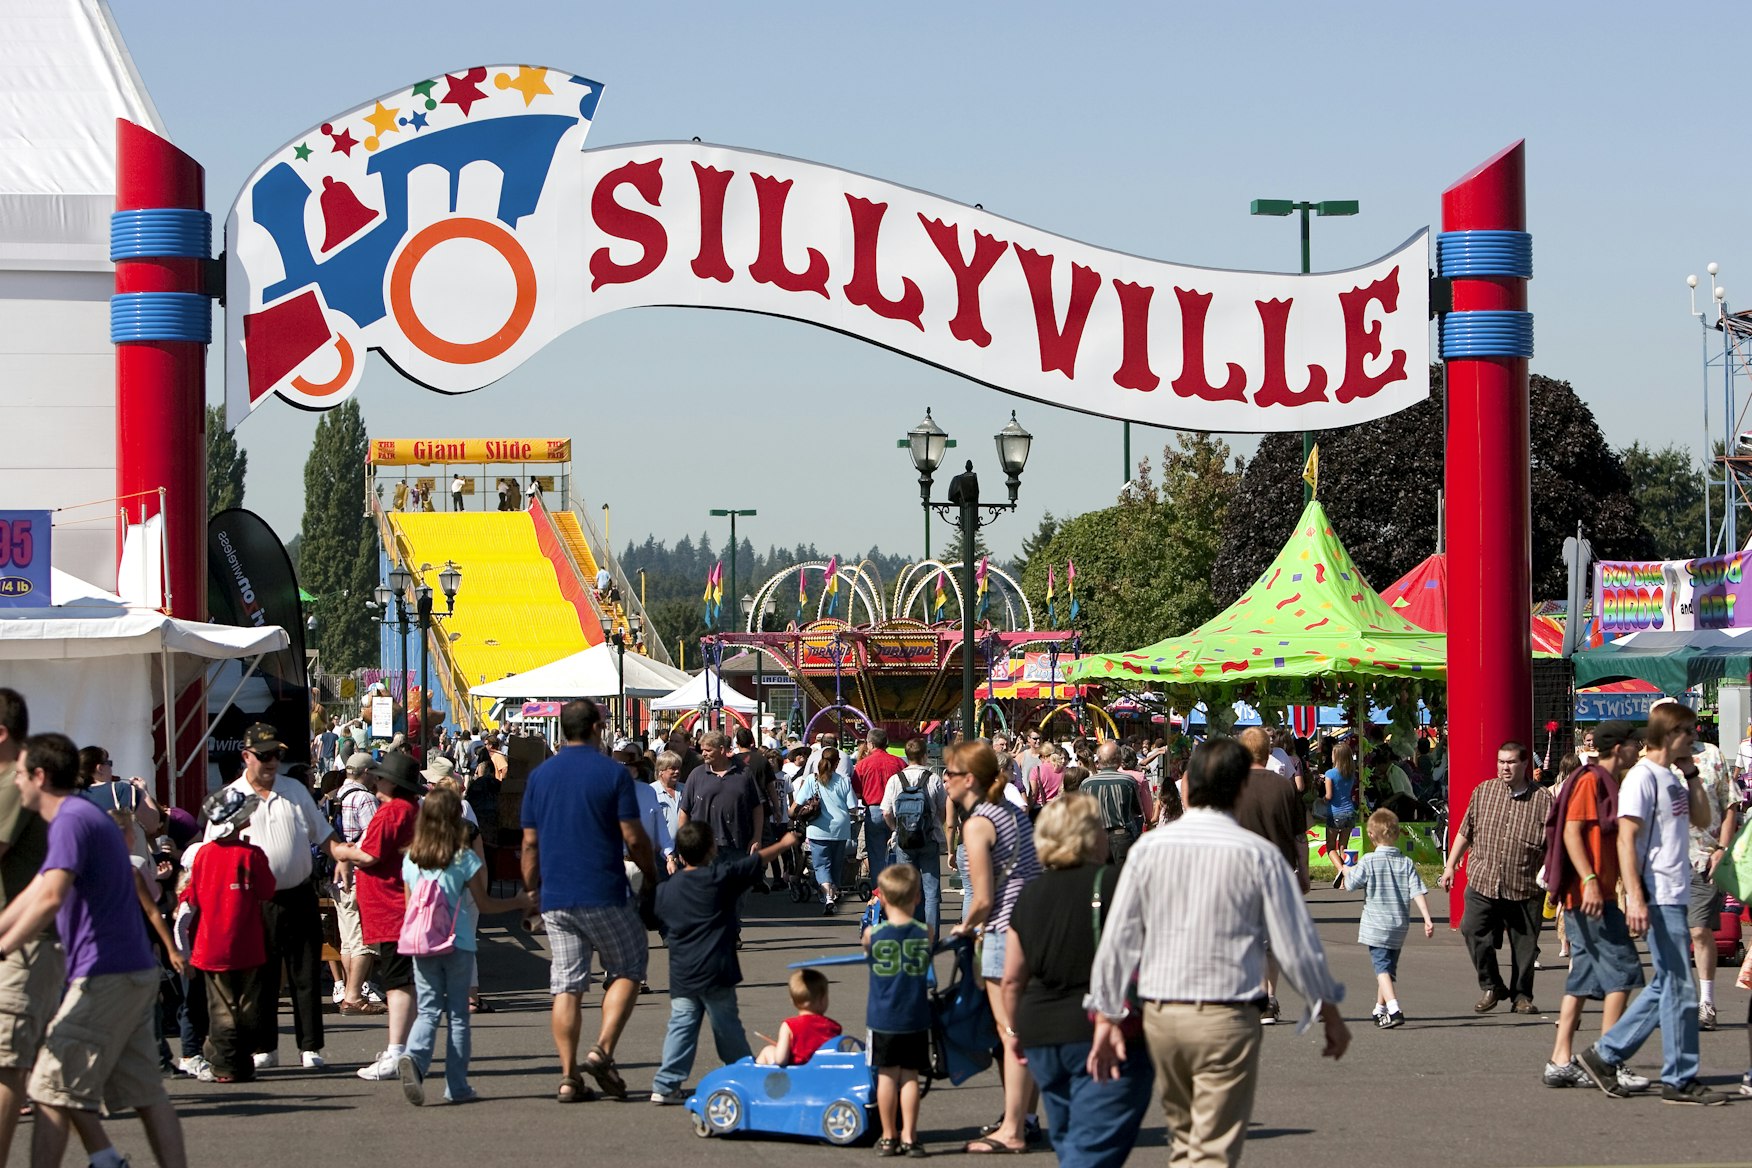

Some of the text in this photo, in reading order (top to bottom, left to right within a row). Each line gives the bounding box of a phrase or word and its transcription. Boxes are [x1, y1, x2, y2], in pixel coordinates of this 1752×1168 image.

[589, 157, 1407, 408] SILLYVILLE
[413, 440, 532, 460] Giant Slide
[1602, 586, 1665, 630] BIRDS
[872, 938, 929, 976] 95
